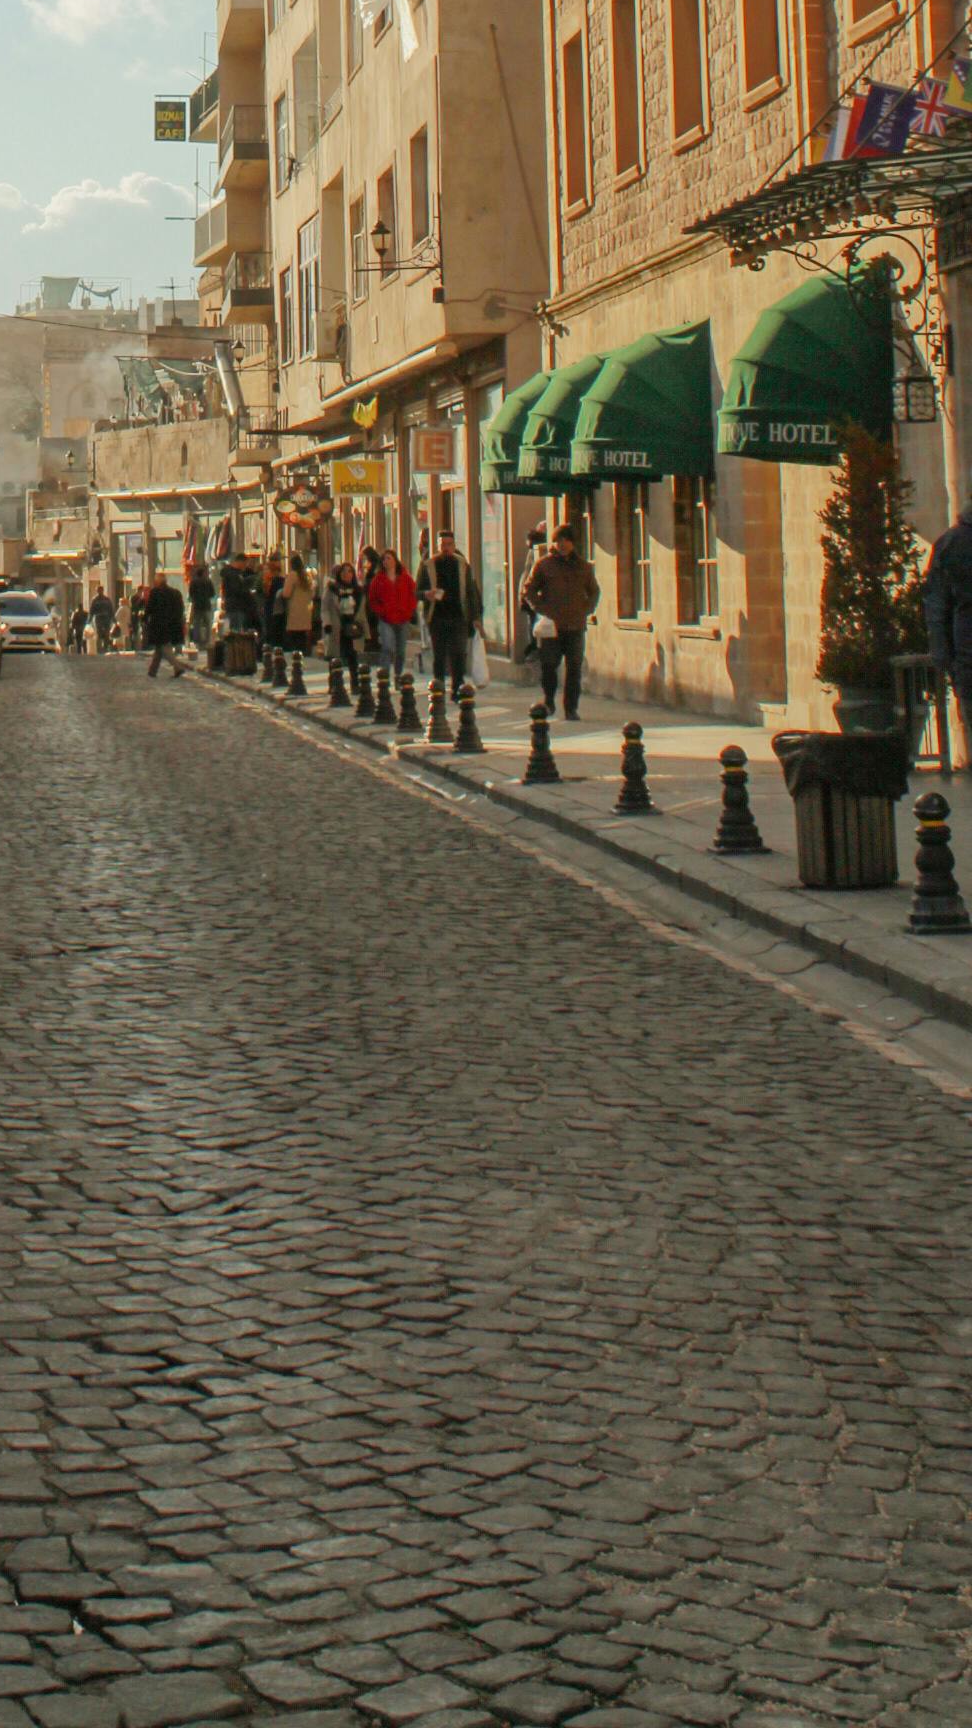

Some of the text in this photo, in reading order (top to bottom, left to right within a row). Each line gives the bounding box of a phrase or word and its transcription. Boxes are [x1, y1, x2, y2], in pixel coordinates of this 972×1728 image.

[768, 422, 838, 446] HOTEL
[603, 450, 652, 469] HOTEL
[339, 479, 374, 494] iddaa
